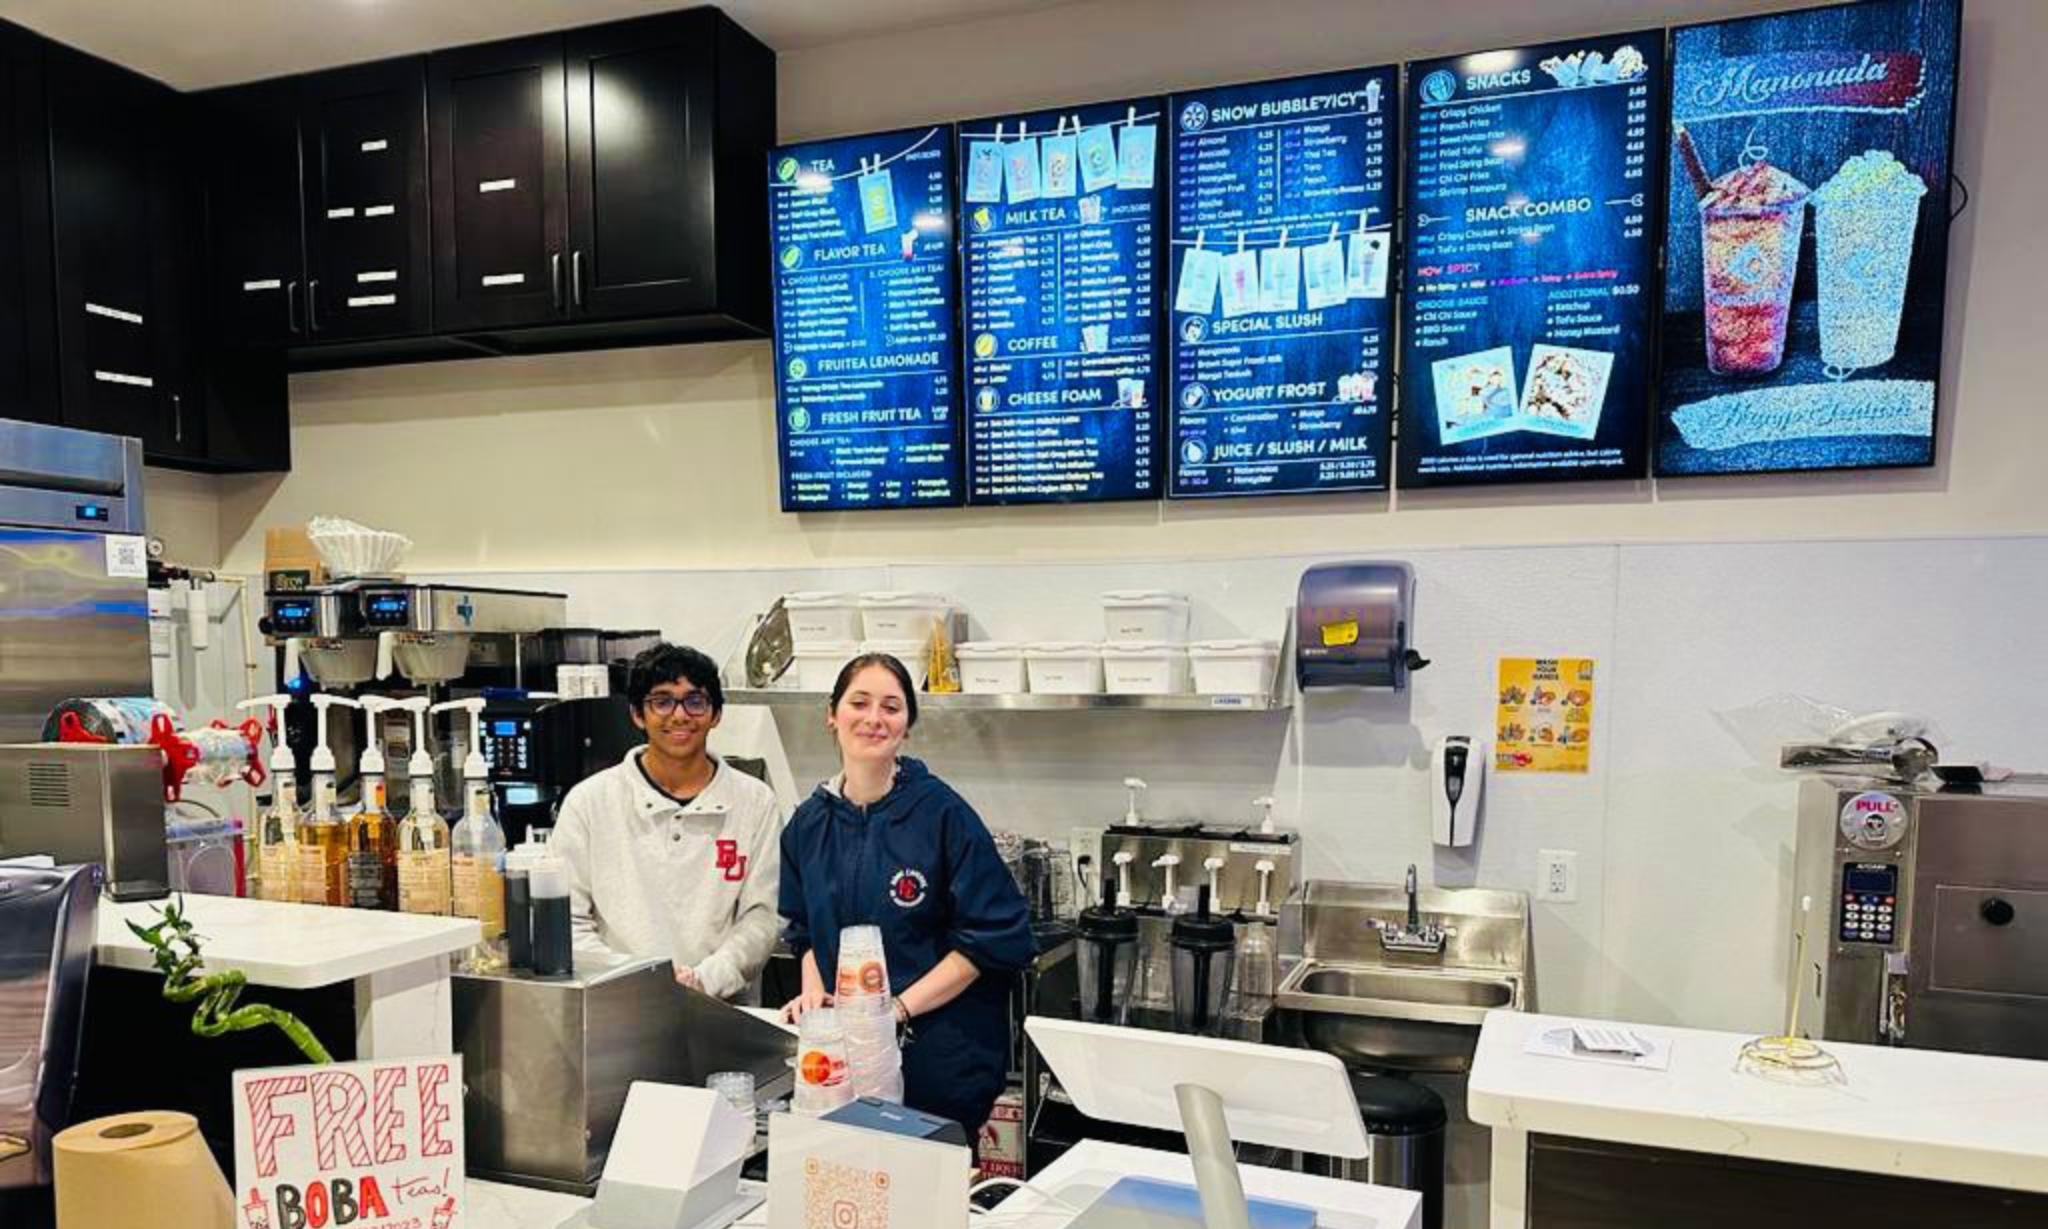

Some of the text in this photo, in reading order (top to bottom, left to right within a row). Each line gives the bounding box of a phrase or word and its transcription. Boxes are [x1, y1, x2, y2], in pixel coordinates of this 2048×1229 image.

[1466, 70, 1531, 90] SNACKS
[1212, 104, 1258, 122] SNOW
[1440, 104, 1501, 120] Crispy Chicken
[1440, 118, 1489, 132] French Fries
[1198, 136, 1227, 146] Almond
[1198, 149, 1231, 159] Avocado
[1440, 146, 1482, 158] Fried Tofu
[812, 160, 835, 172] TEA
[1440, 161, 1458, 172] Fried
[1470, 172, 1489, 181] Fries
[1228, 184, 1246, 193] Fruit
[1439, 187, 1468, 199] Shrimp
[1006, 207, 1066, 224] MILK TEA
[1466, 198, 1591, 222] SNACK COMBO
[1438, 230, 1464, 243] Crispy
[1466, 227, 1498, 238] Chicken
[814, 244, 886, 261] FLAVOR TEA
[1439, 240, 1512, 254] Tofu String Bean
[1417, 263, 1481, 277] HOW SPICY
[1548, 288, 1609, 299] ADDITIONAL
[1416, 296, 1488, 310] CHOOSE SAUCE
[1555, 303, 1591, 314] Ketchup
[1453, 311, 1477, 319] Sauce
[1555, 314, 1602, 325] Tofu Sauce
[1212, 312, 1323, 334] SPECIAL SLUSH
[1442, 324, 1466, 333] Sauce
[1554, 325, 1620, 339] Honey Mustard
[1008, 336, 1058, 351] COFFEE
[818, 352, 939, 371] FRUITEA LEMONADE
[1008, 388, 1101, 405] CHEESE FOAM
[1213, 382, 1326, 402] YOGURT FROST
[821, 408, 922, 425] FRESH FRUIT TEA
[1230, 412, 1279, 422] Combination
[1298, 421, 1342, 431] Strawberry
[1213, 437, 1367, 461] JUICE / SLUSH / MILK
[1855, 799, 1895, 813] PULL
[245, 1064, 453, 1178] FREE
[275, 1167, 450, 1229] BOBA teas!
